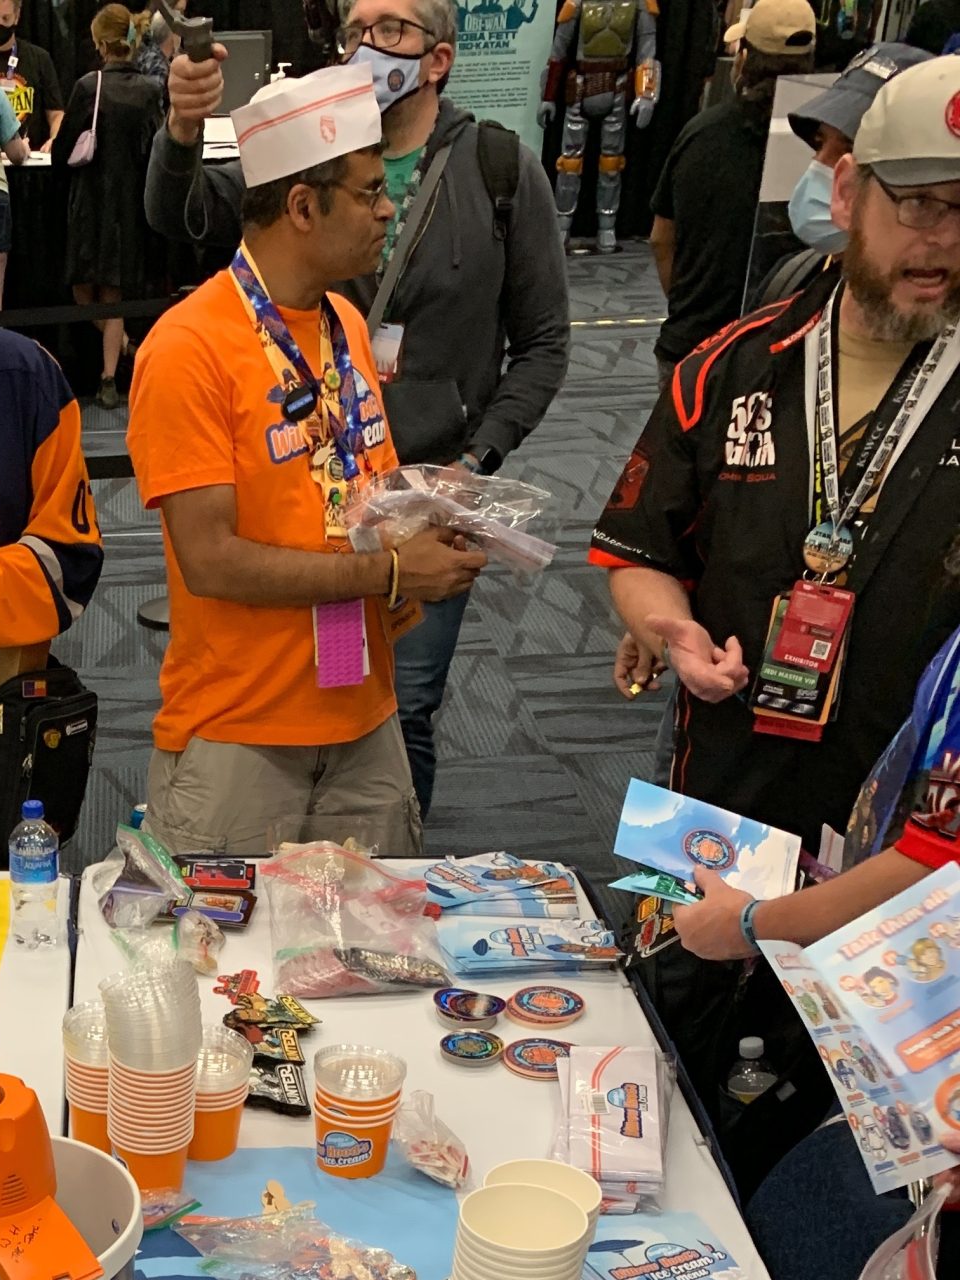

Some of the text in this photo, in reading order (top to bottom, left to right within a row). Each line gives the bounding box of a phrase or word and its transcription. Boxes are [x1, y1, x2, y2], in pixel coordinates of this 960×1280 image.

[458, 32, 485, 41] OBA
[784, 653, 819, 669] EXHIBITOR
[763, 667, 816, 685] JEDI MASTER VIP
[337, 1152, 370, 1166] Cream
[671, 1256, 713, 1278] Cream
